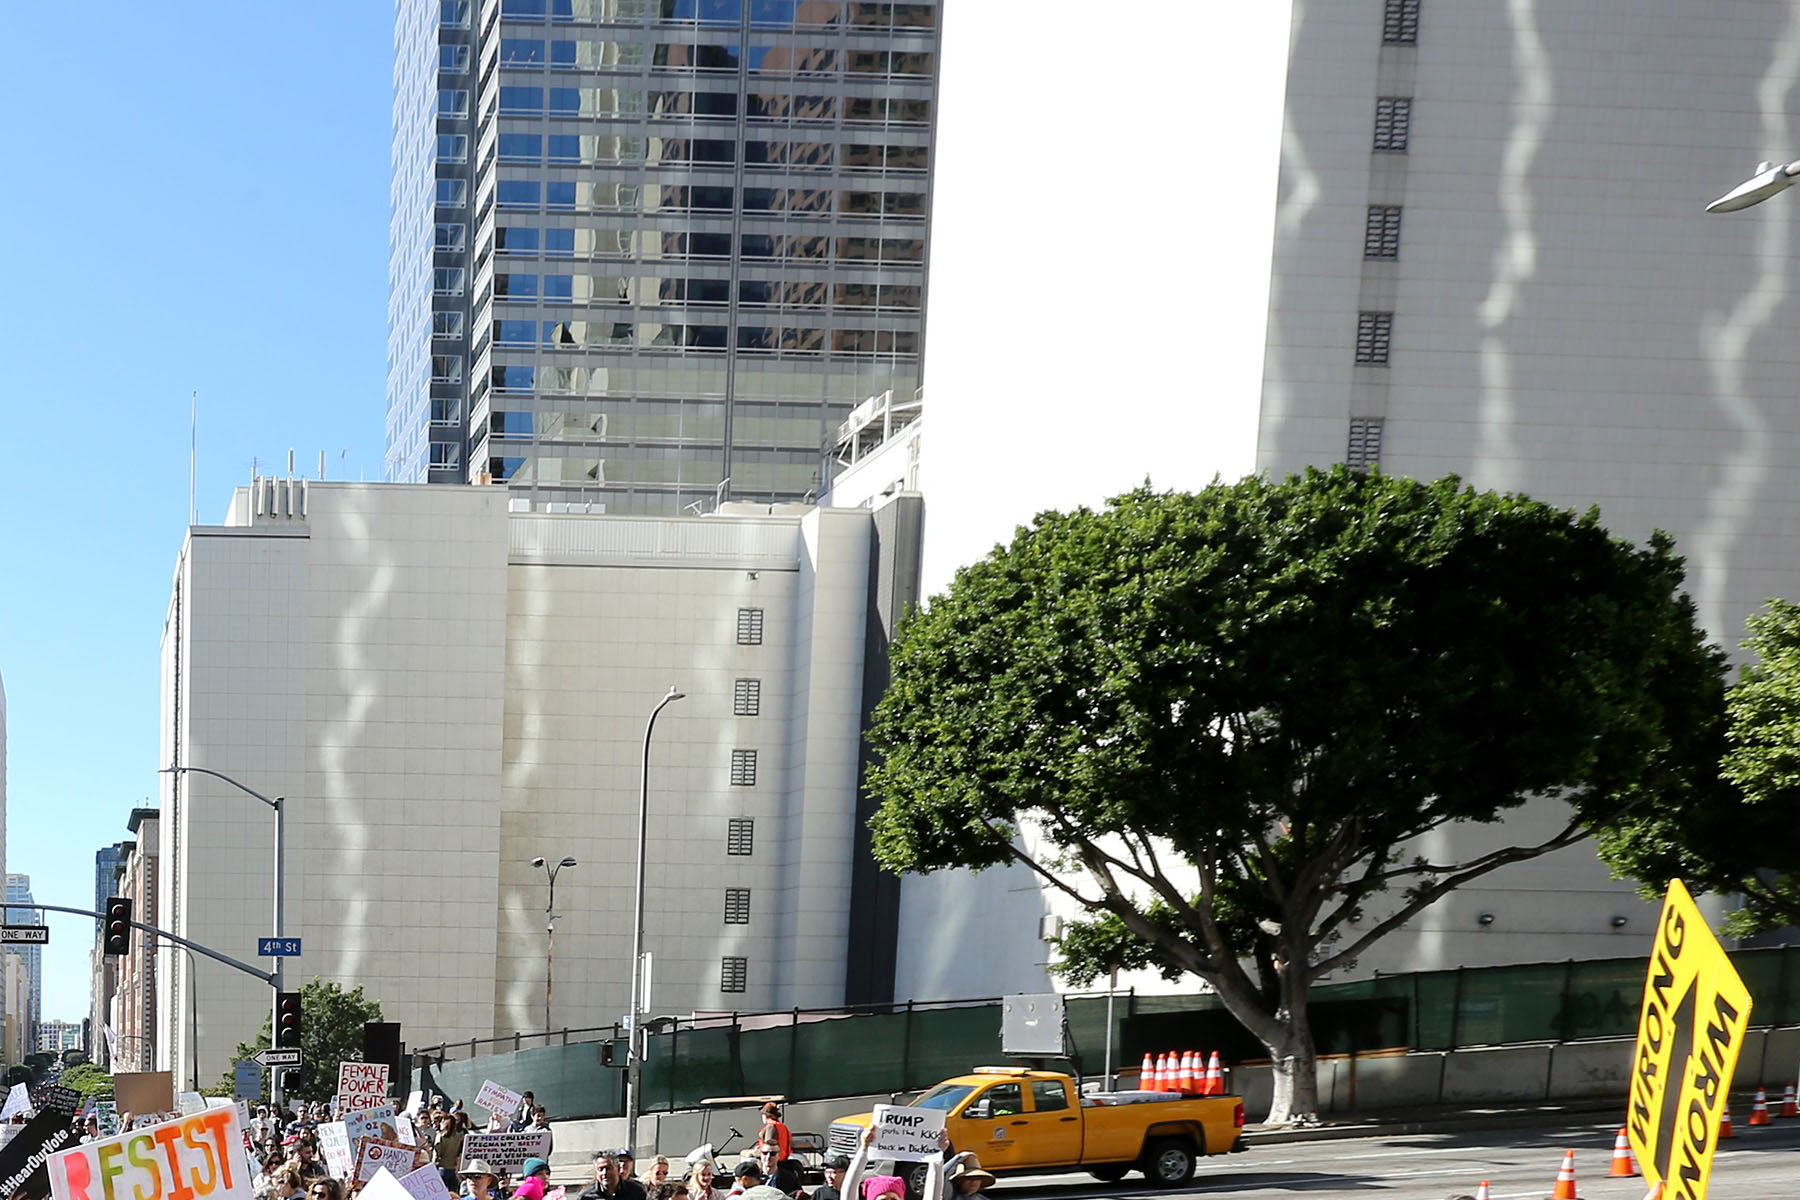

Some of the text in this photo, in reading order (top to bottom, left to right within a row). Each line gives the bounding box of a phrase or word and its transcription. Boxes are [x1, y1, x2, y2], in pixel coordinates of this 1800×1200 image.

[1, 931, 43, 939] ONE WAY
[264, 941, 297, 953] 4th St
[1632, 904, 1686, 1147] WRONG
[339, 1077, 384, 1093] POWER
[338, 1094, 386, 1108] FIGHTS
[879, 1109, 924, 1127] TRUMP
[365, 1122, 378, 1130] OZ
[0, 1129, 69, 1196] #HearOurVote
